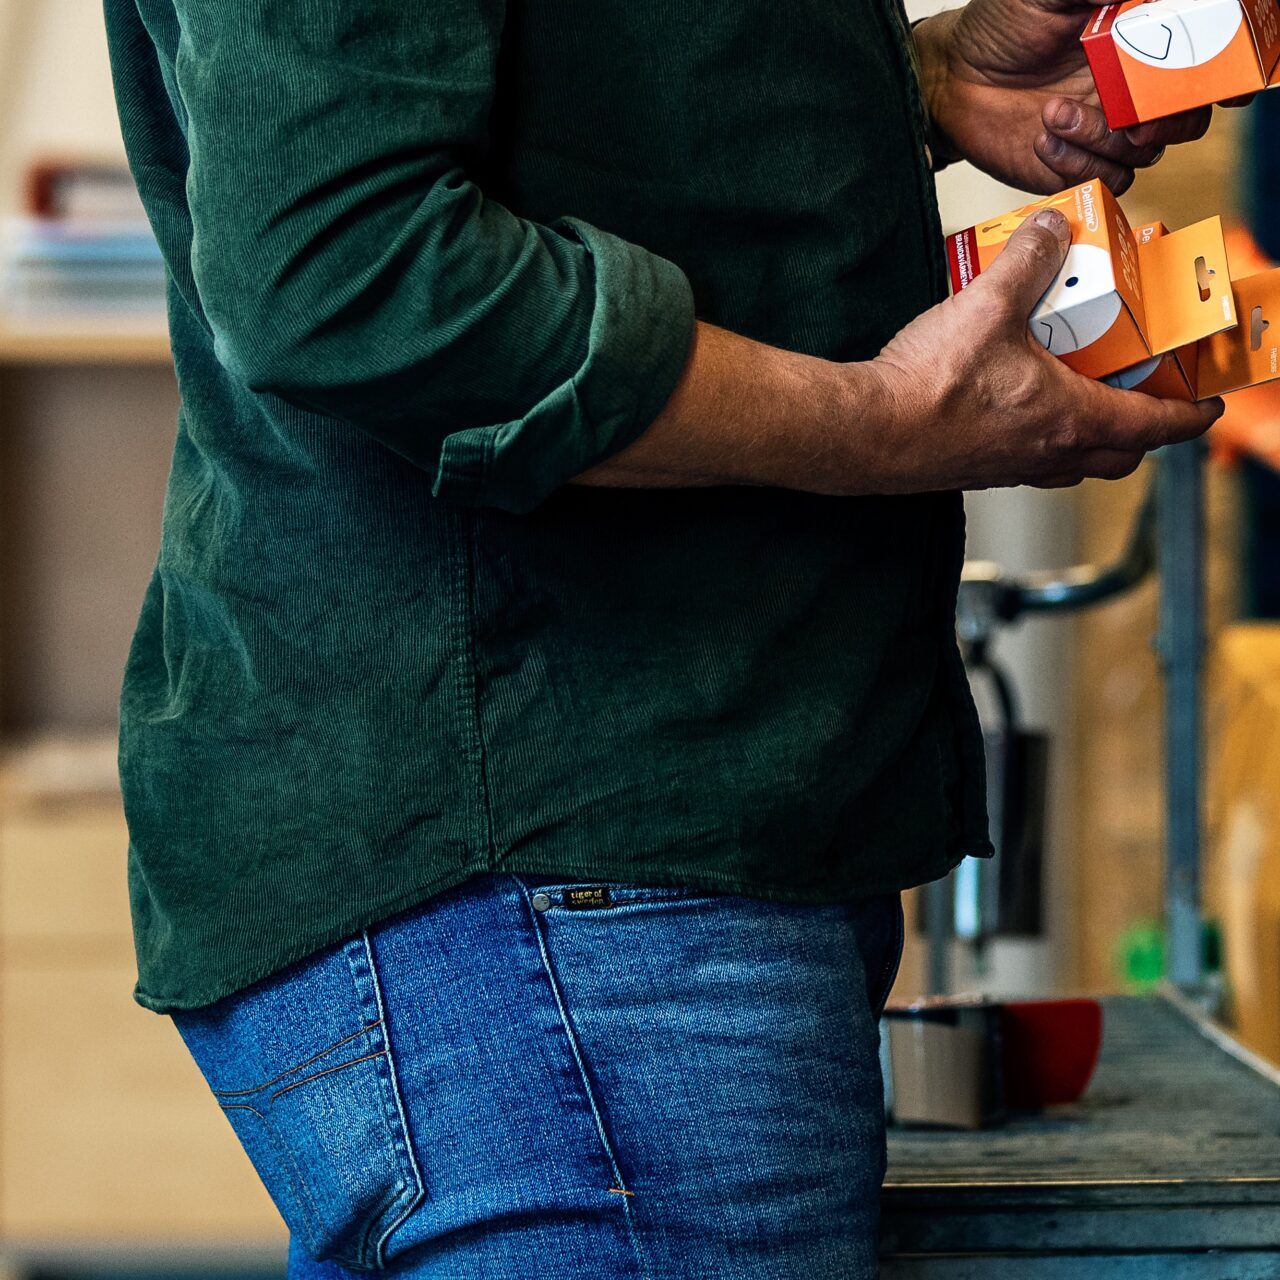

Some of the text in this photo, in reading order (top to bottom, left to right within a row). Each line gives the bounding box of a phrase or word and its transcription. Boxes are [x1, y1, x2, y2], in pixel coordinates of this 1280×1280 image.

[1081, 184, 1097, 230] Deltronic
[1142, 227, 1153, 244] De
[570, 890, 593, 899] tiger
